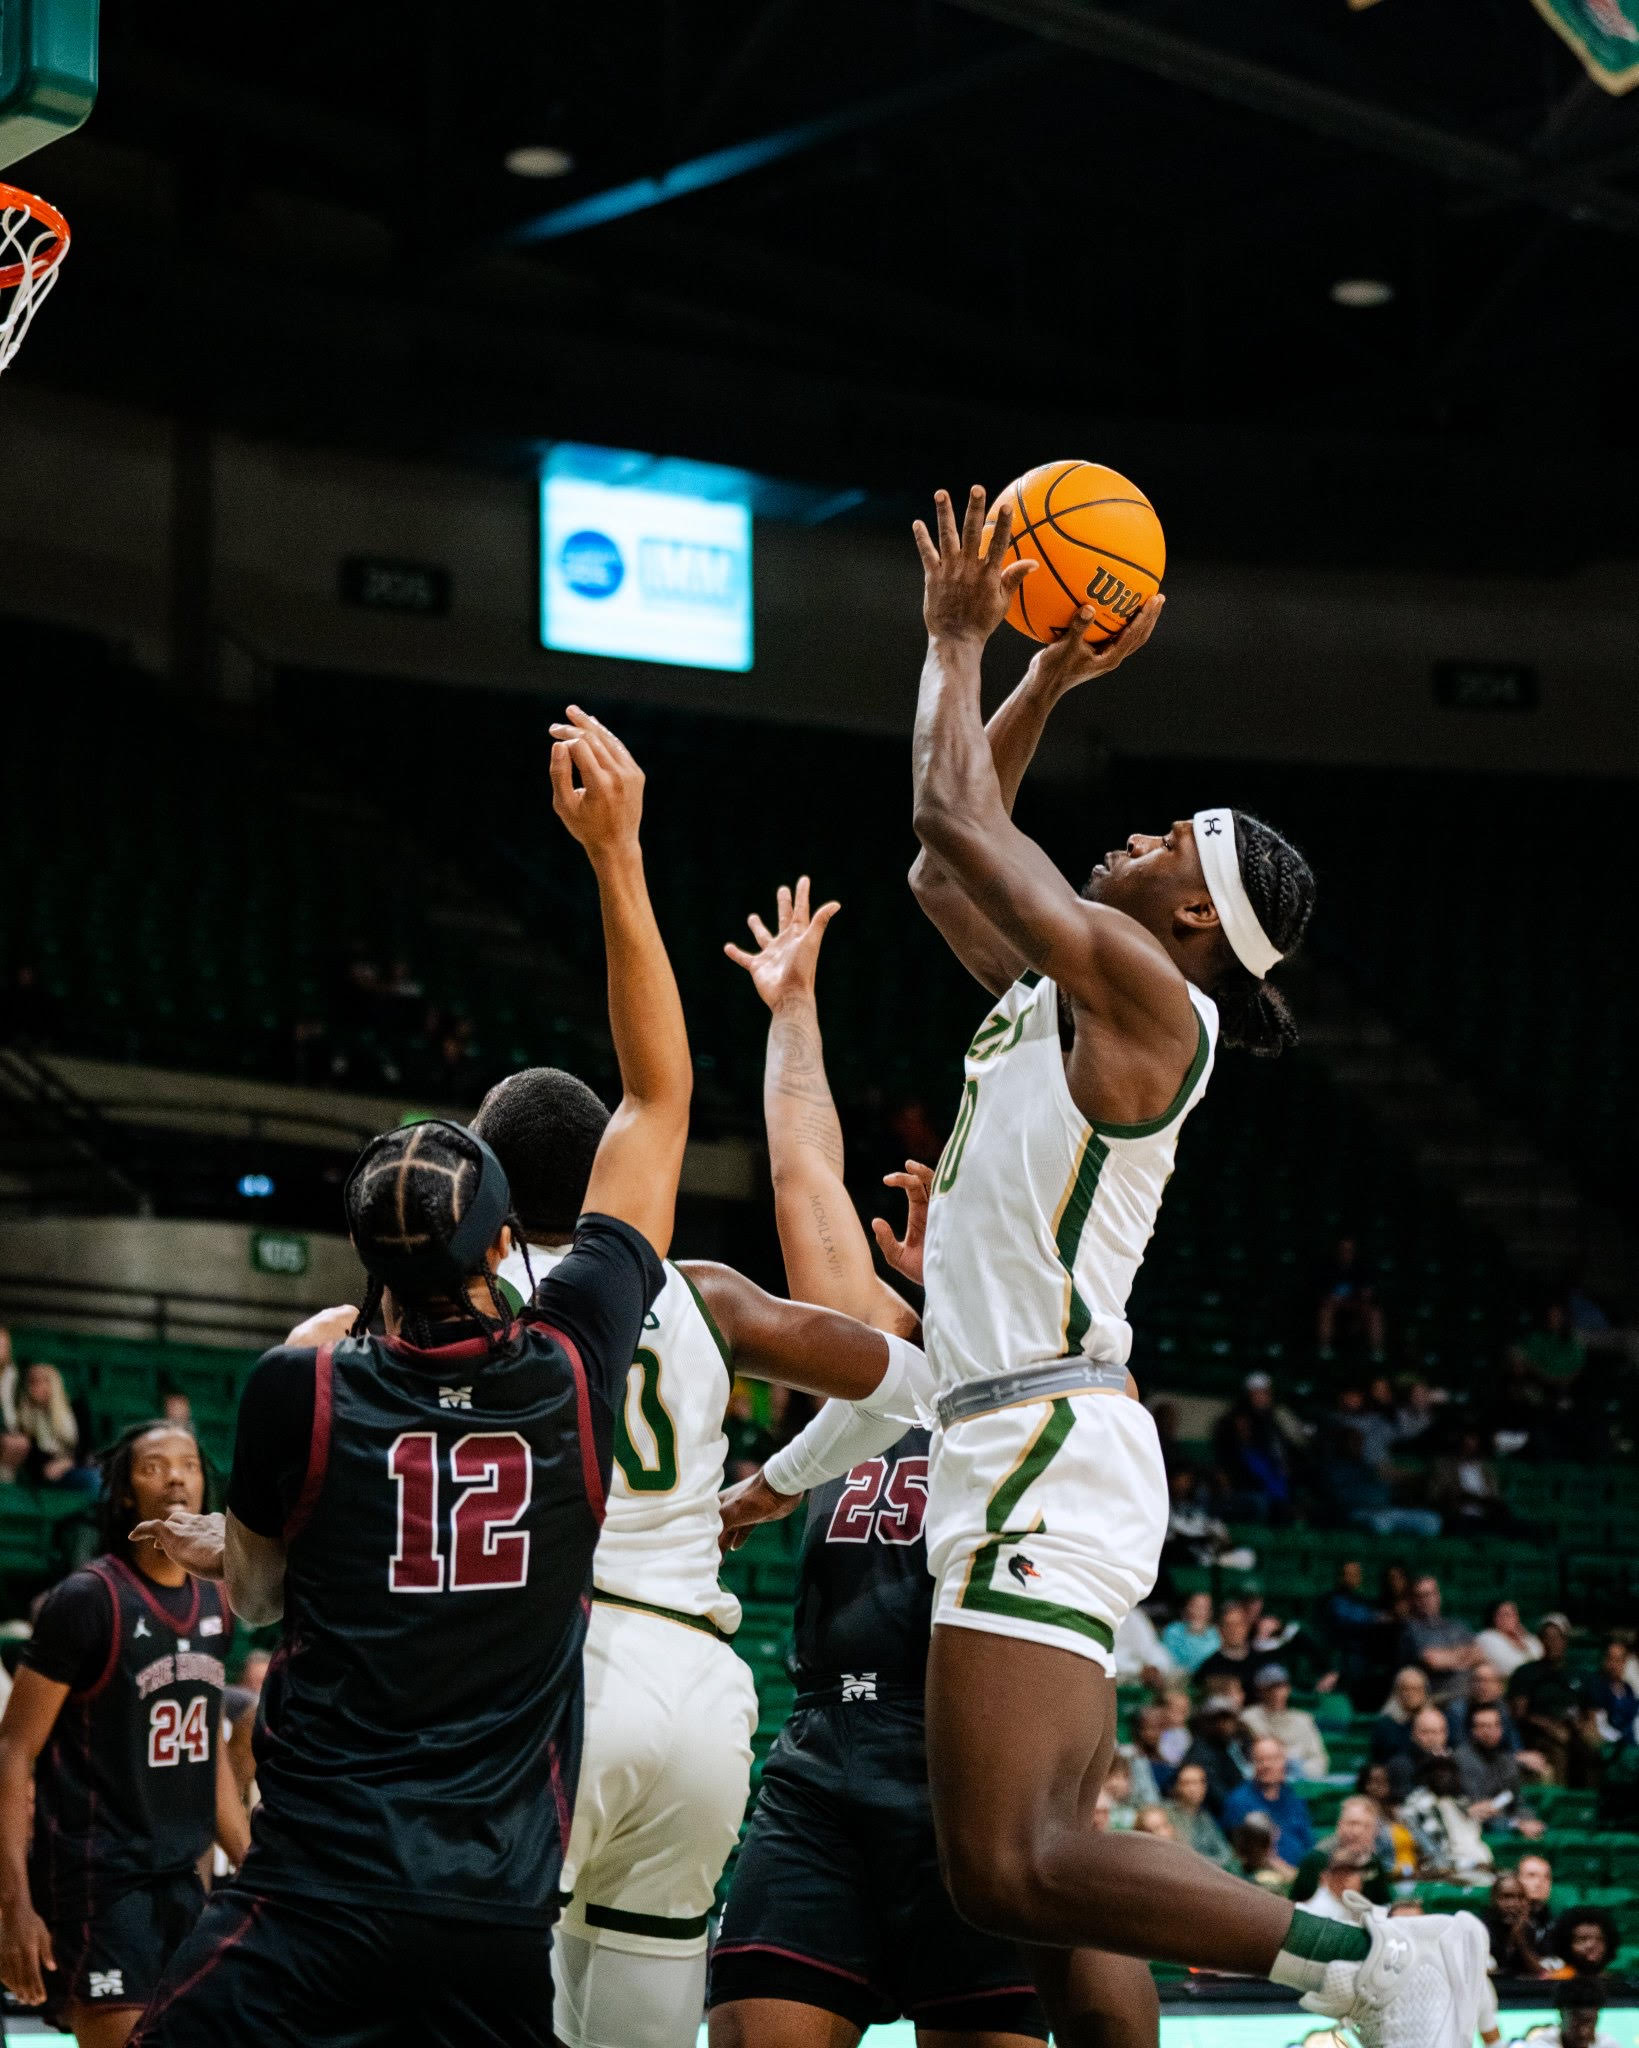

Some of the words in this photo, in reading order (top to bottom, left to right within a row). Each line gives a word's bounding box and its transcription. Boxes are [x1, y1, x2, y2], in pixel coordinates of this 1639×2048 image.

[1086, 566, 1142, 618] Wil
[387, 1431, 533, 1593] 12
[825, 1455, 929, 1546] 25
[148, 1695, 210, 1768] 24
